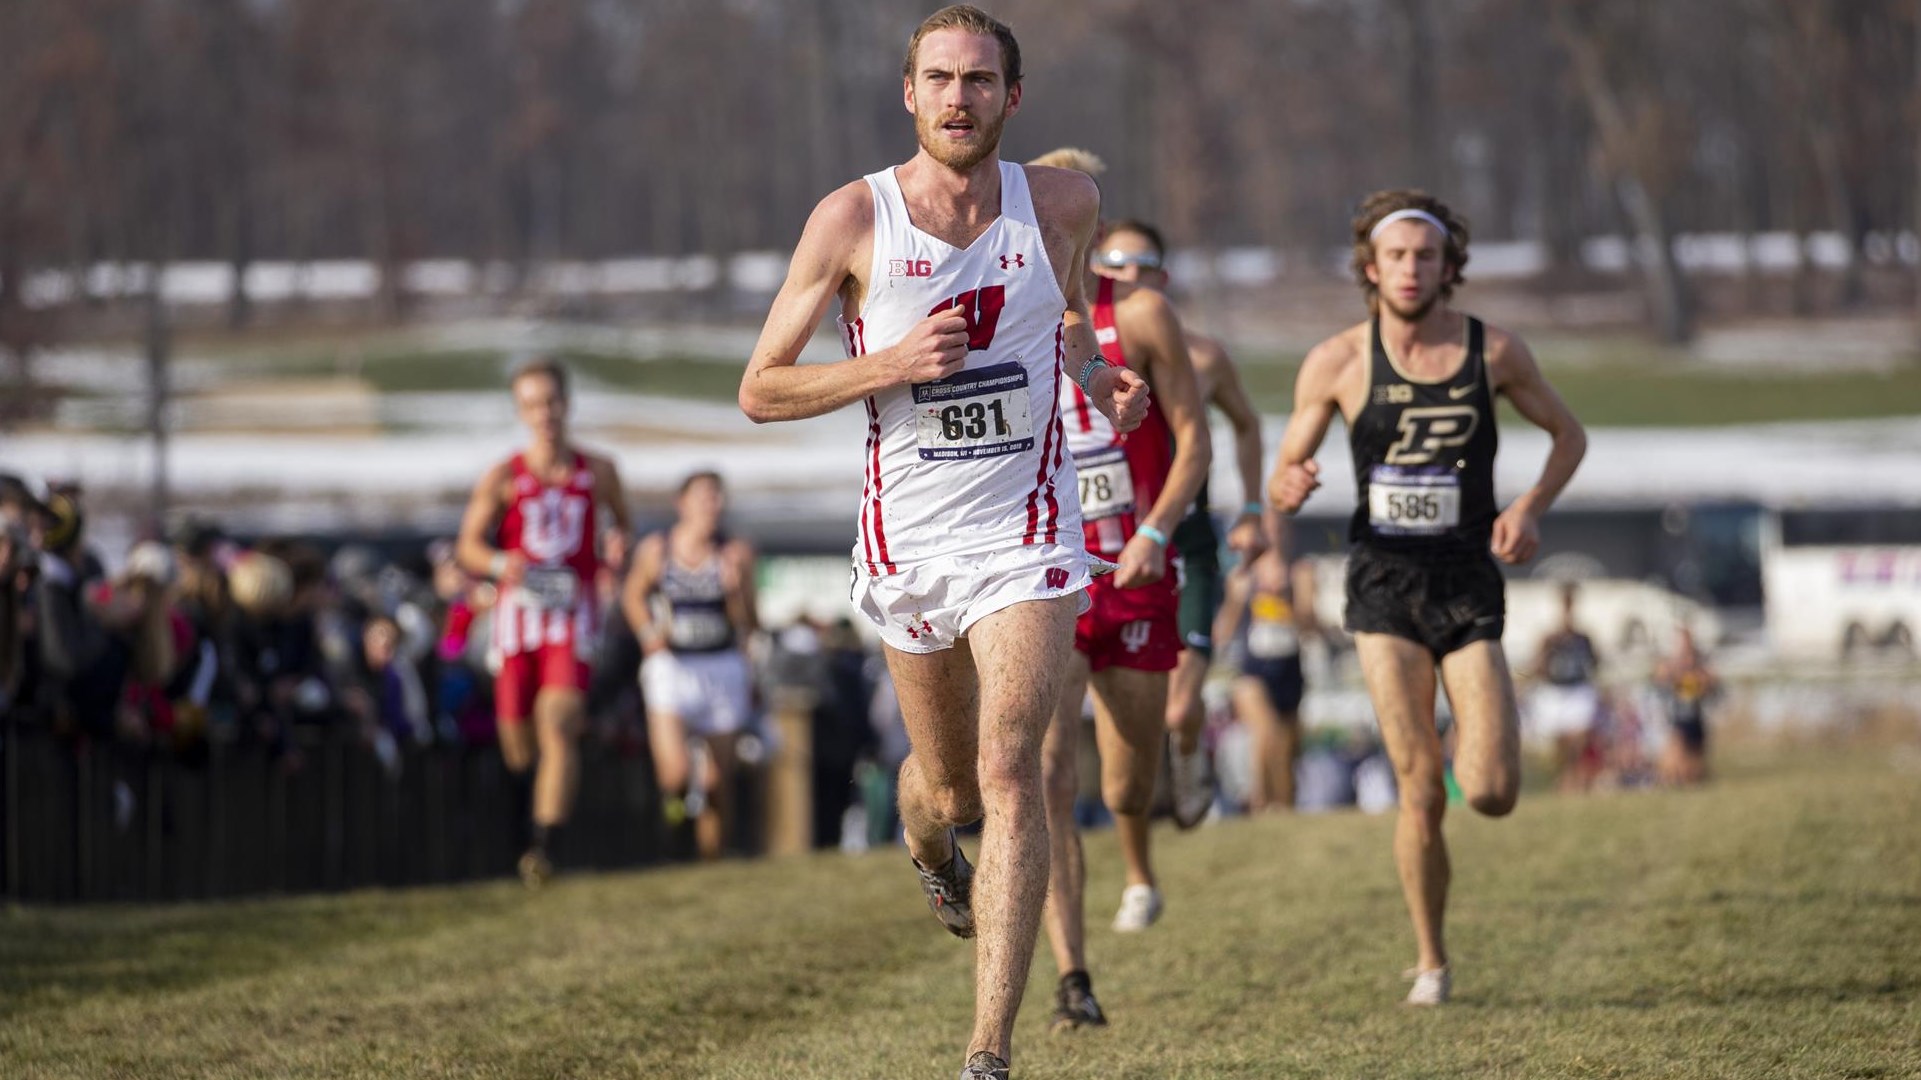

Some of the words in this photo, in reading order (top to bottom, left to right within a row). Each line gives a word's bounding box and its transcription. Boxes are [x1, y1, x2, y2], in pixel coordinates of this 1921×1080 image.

[931, 387, 951, 396] CROSS
[951, 381, 977, 393] COUNTRY
[978, 373, 1024, 388] CHAMPIONSHIPS
[941, 399, 1006, 441] 631
[1385, 405, 1479, 464] P
[972, 446, 1000, 455] NOVEMBER
[1045, 568, 1069, 589] W
